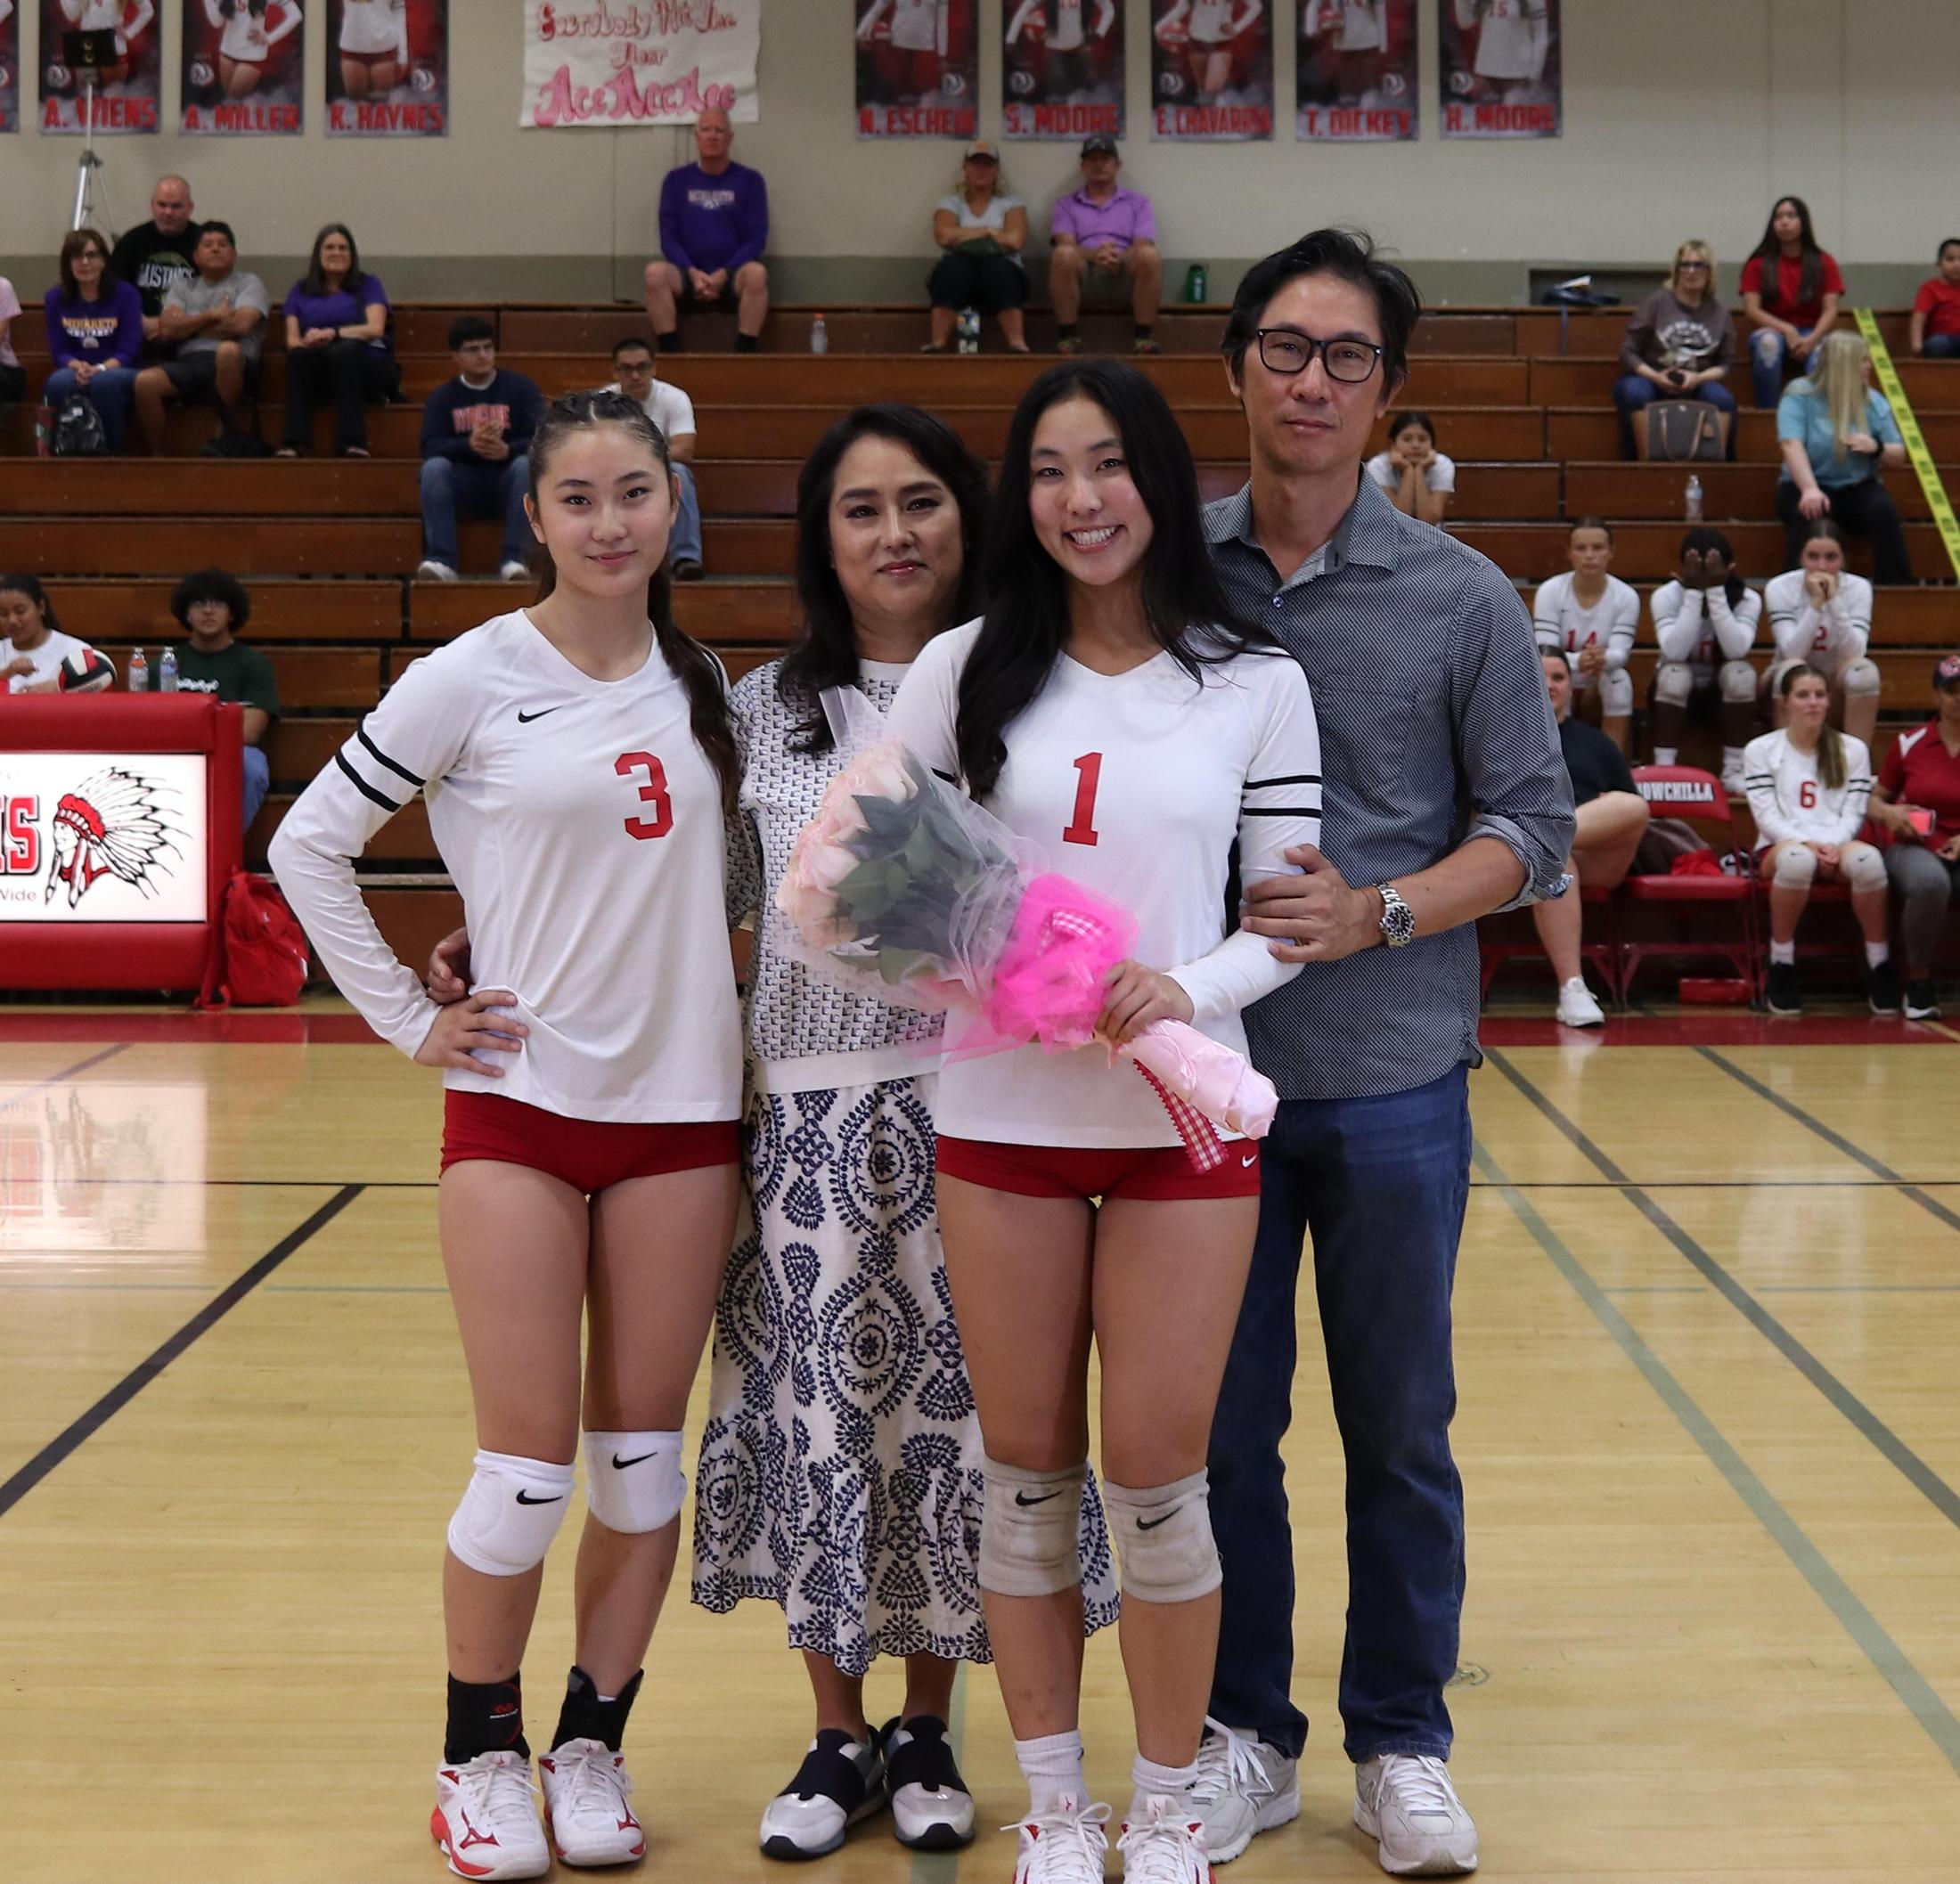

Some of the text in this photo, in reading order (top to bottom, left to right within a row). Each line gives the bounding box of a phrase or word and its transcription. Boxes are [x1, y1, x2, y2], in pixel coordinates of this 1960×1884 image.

[534, 65, 608, 126] Ace
[605, 65, 677, 118] Ace
[45, 95, 157, 128] A. WIENS
[184, 104, 300, 131] A. MILLER
[330, 102, 444, 131] K. HAYNES
[1007, 103, 1120, 135] S. MOORE
[1306, 108, 1412, 135] T. DICKEY
[1474, 103, 1555, 131] MOORE
[1812, 626, 1828, 651] 2
[615, 751, 674, 841] 3
[1063, 751, 1104, 847] 1
[1637, 781, 1715, 803] OWCHILLA
[1801, 780, 1818, 809] 6
